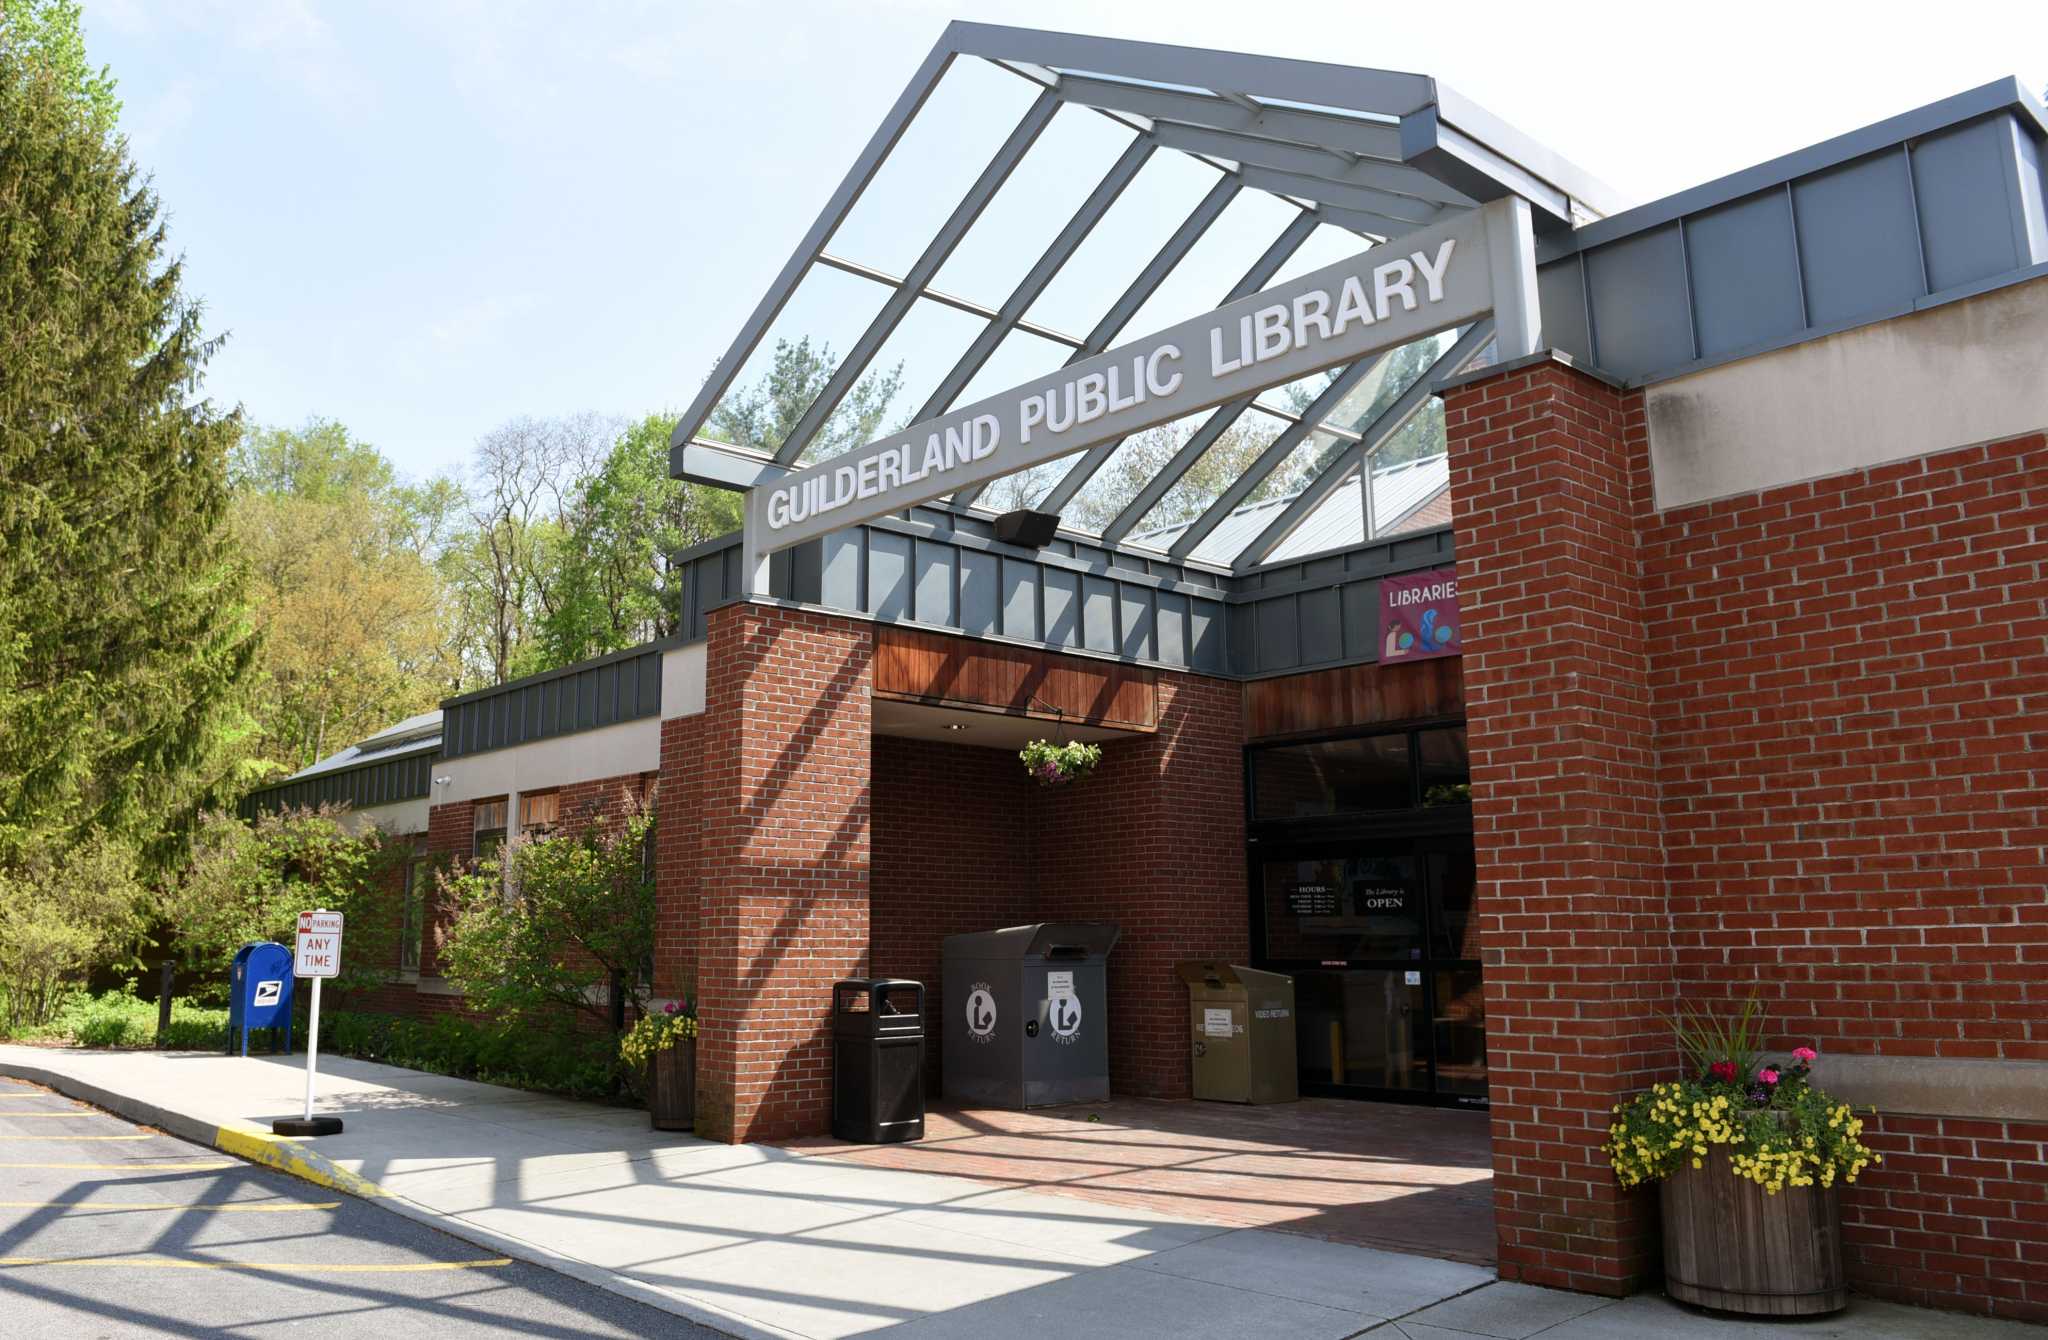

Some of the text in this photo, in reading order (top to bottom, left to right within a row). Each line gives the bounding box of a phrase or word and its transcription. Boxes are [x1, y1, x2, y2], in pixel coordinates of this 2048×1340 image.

[767, 239, 1456, 529] GUILDERLAND PUBLIC LIBRARY
[1375, 887, 1398, 897] Library
[1367, 897, 1403, 908] OPEN
[300, 917, 340, 928] NO PARKING
[306, 938, 331, 950] ANY
[304, 954, 331, 967] TIME
[970, 981, 992, 992] BOOK
[967, 1028, 996, 1044] RETURN
[1050, 1028, 1081, 1045] RETURN
